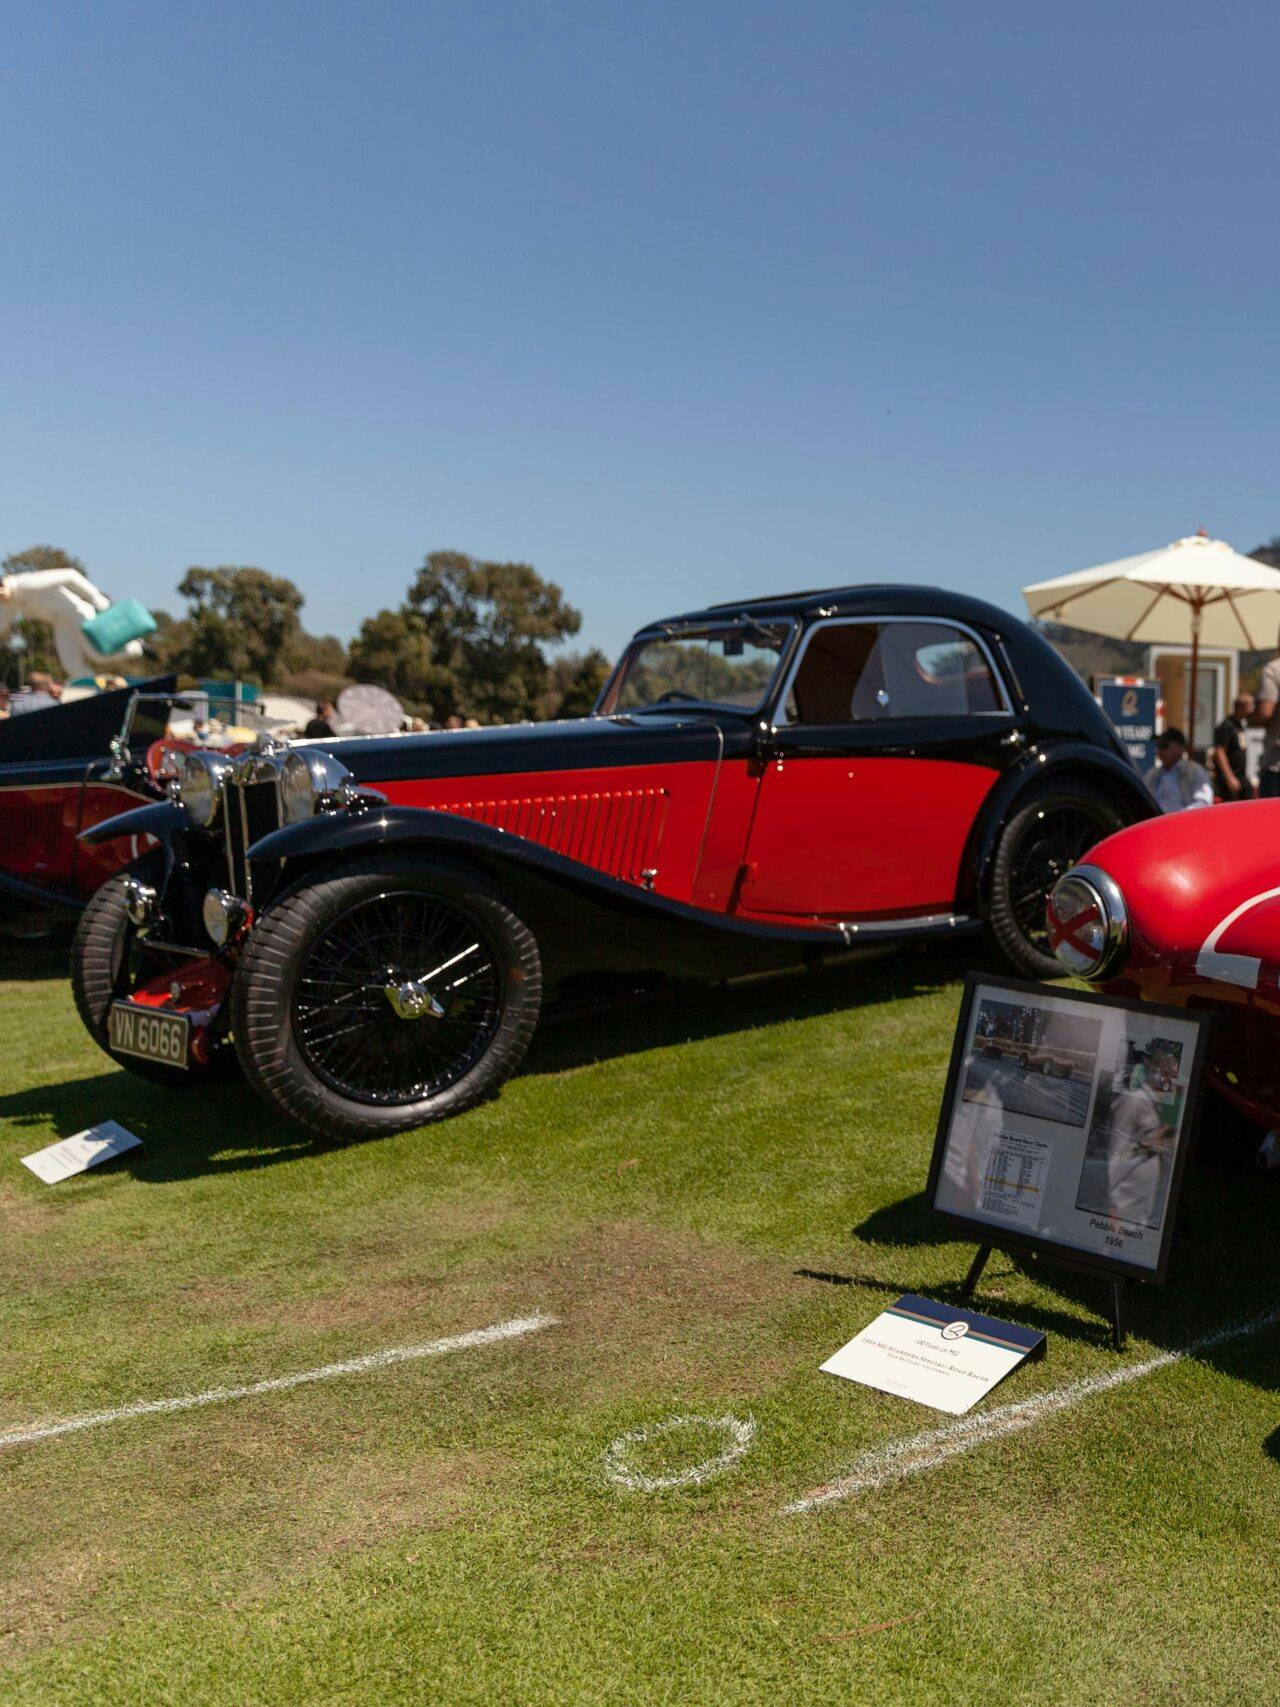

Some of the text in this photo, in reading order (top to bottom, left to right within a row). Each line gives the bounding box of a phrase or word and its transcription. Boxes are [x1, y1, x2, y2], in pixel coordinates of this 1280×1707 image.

[116, 1009, 181, 1060] VN 6066
[1089, 1218, 1143, 1240] Pebble Beach
[1105, 1235, 1124, 1248] 1956
